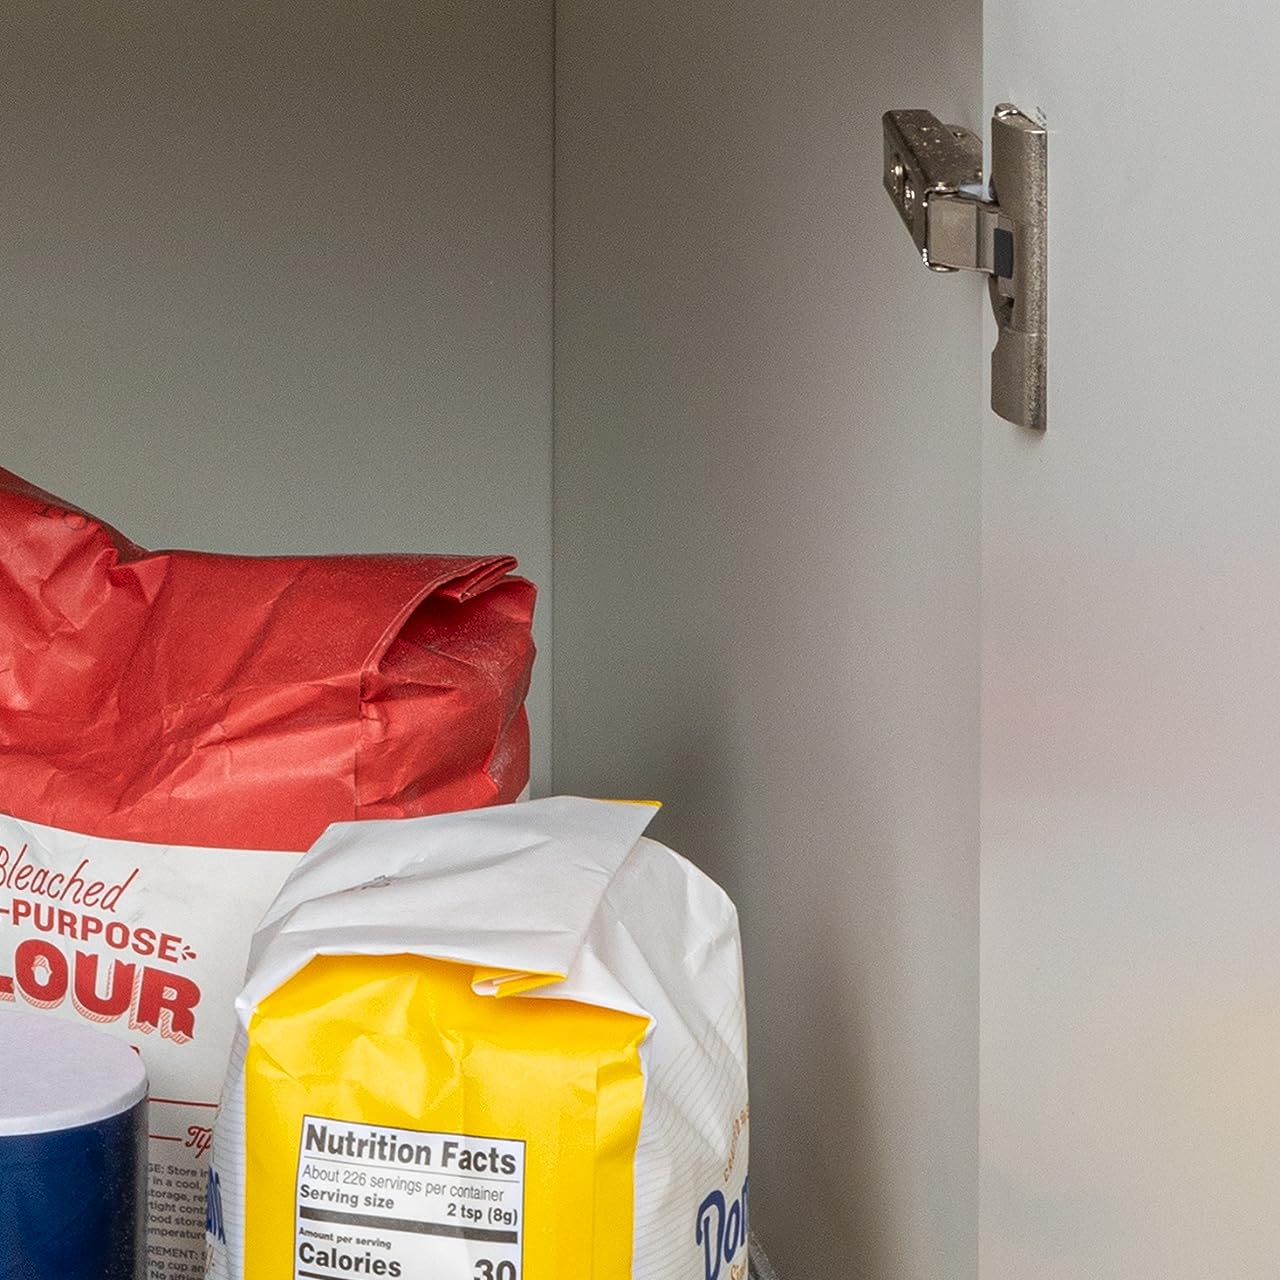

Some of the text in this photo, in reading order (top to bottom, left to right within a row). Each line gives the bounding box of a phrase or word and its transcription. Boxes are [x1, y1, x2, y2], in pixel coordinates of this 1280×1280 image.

[305, 1124, 516, 1174] Nutrition Facts
[168, 1165, 197, 1176] Store
[302, 1165, 504, 1201] About 226 servings per container
[175, 1181, 202, 1191] cool,
[300, 1185, 518, 1225] Serving size 2 tsp (8g)
[299, 1228, 391, 1249] Amount per serving
[168, 1262, 188, 1272] cup
[299, 1243, 401, 1277] Calories
